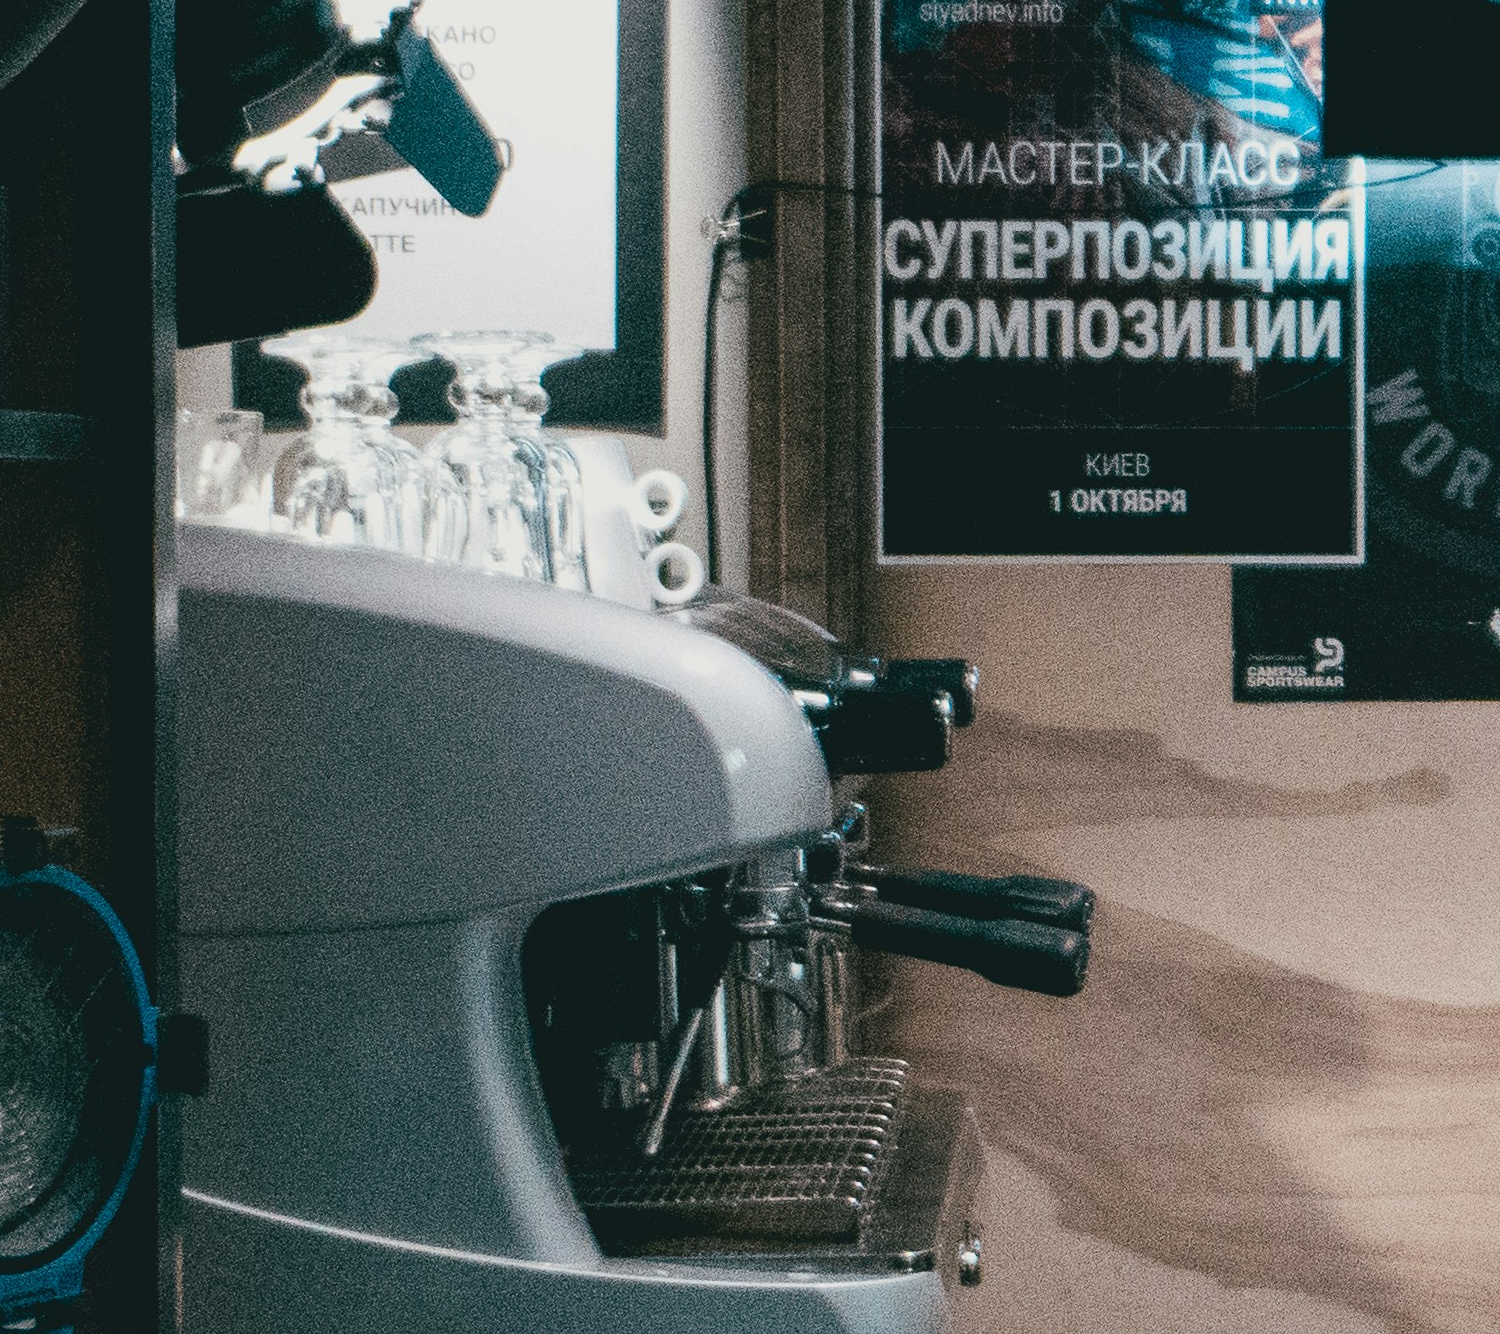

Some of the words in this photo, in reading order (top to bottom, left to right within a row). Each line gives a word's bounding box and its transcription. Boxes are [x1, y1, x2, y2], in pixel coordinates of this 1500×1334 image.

[936, 140, 1301, 188] МАСТЕР-КЛАСС
[883, 218, 1351, 293] СУПЕРПОЗИЦИЯ
[891, 298, 1342, 372] КОМПОЗИЦИИ
[1085, 452, 1151, 479] КИЕВ
[1050, 489, 1062, 513] 1
[1070, 488, 1188, 514] ОКТЯБРЯ
[1246, 676, 1345, 688] SPORTSWEAR
[1247, 665, 1307, 677] CAMPUS
